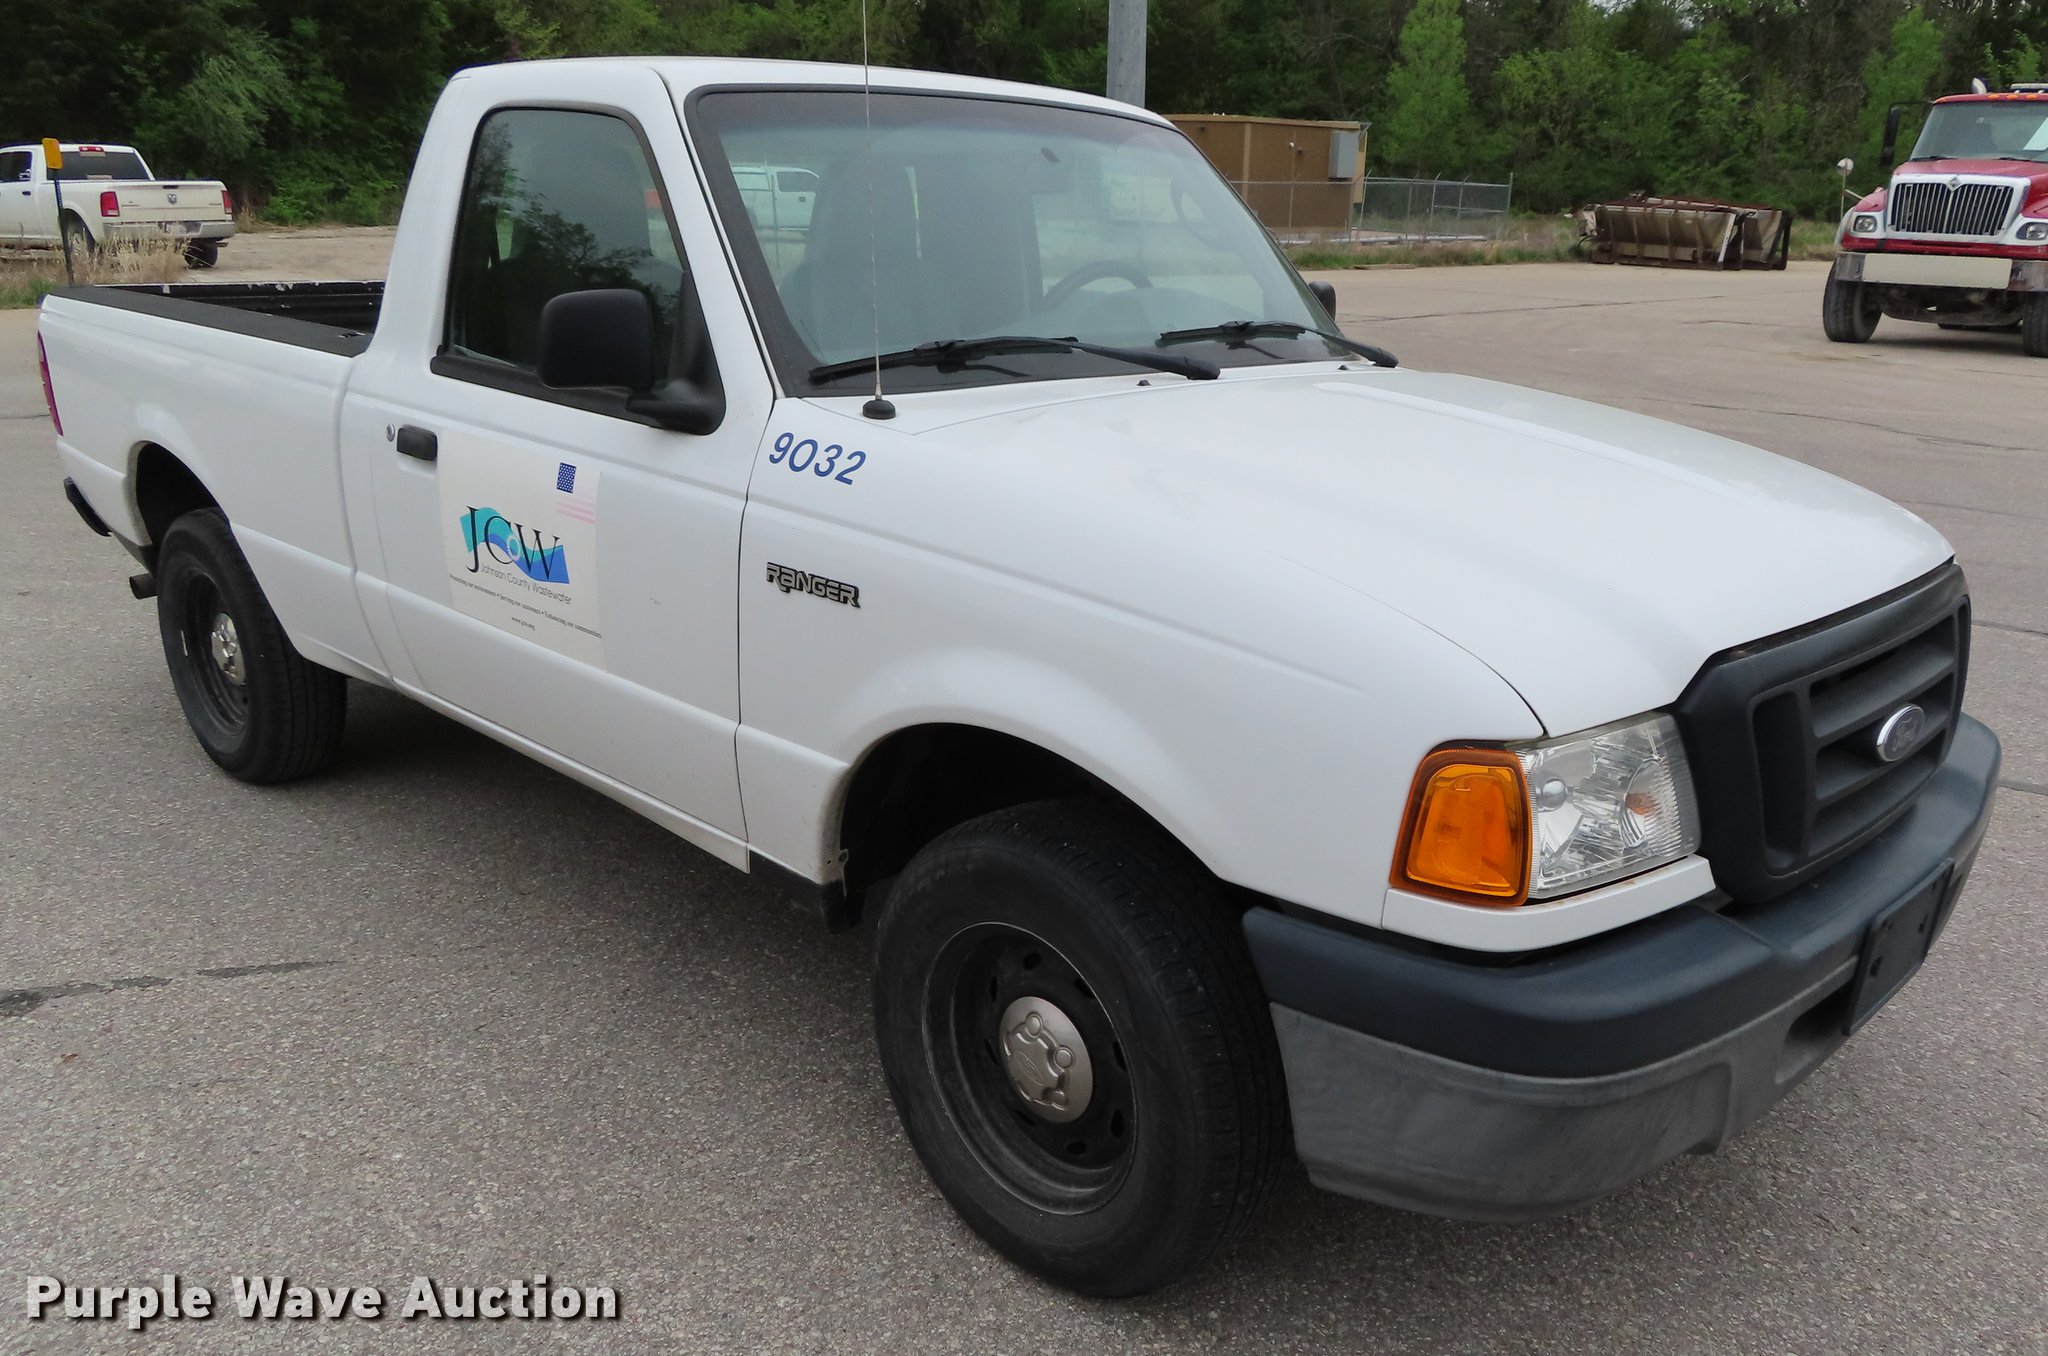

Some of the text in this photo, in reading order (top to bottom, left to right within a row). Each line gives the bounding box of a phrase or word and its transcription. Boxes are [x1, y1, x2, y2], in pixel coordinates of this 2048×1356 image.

[769, 432, 867, 486] 9032
[465, 505, 561, 580] JCW
[481, 564, 507, 581] Johnson
[507, 572, 531, 592] County
[532, 582, 572, 606] Wastewater
[766, 561, 861, 609] RANGER
